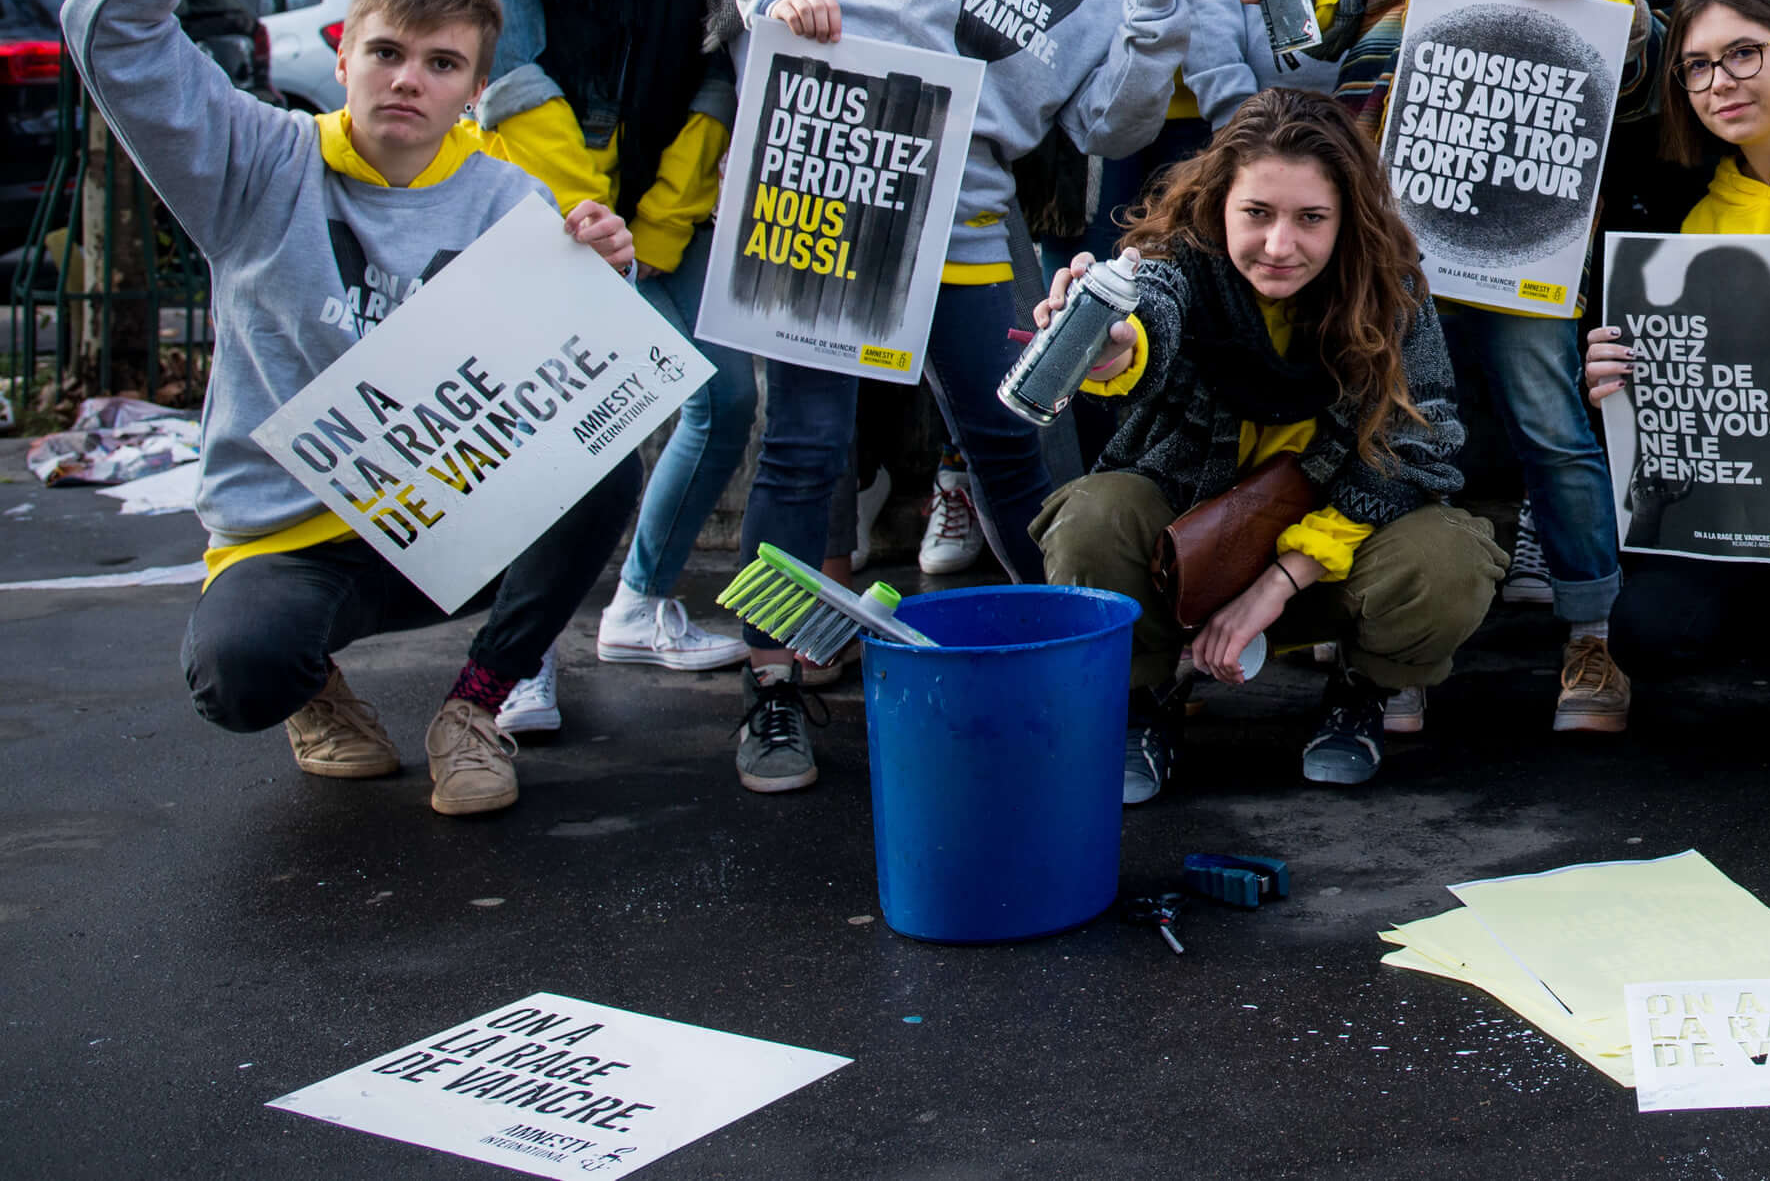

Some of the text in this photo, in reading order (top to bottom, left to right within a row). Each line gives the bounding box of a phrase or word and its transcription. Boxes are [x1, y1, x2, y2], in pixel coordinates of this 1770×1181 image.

[778, 71, 869, 124] VOUS
[1414, 41, 1589, 103] CHOISISSEZ
[1406, 71, 1586, 134] DES ADVER-
[1400, 104, 1598, 169] SAIRES TROP
[760, 145, 906, 212] PERDRE.
[1391, 166, 1480, 216] VOUS.
[1392, 135, 1583, 201] FORTS POUR
[752, 183, 848, 238] NOUS
[743, 221, 857, 281] AUSSI.
[1626, 315, 1708, 339] VOUS
[1632, 339, 1706, 363] AVEZ
[1633, 362, 1753, 388] PLUS DE
[1634, 386, 1769, 413] POUVOIR
[291, 380, 405, 474] ON A
[329, 356, 506, 514] LA RAGE
[572, 372, 646, 445] AMNESTY
[586, 390, 660, 456] INTERNATIONAL
[1638, 409, 1697, 435] QUE
[370, 334, 619, 550] DE VAINCRE.
[1640, 432, 1720, 460] NE LE
[1642, 456, 1762, 486] PENSEZ.
[486, 1007, 605, 1046] ON A
[1646, 991, 1767, 1016] ON A
[1649, 1016, 1707, 1041] LA
[430, 1028, 632, 1087] LA RAGE
[371, 1050, 656, 1133] DE VAINCRE.
[480, 1134, 569, 1165] INTERNATIONAL
[502, 1123, 596, 1155] AMNESTY
